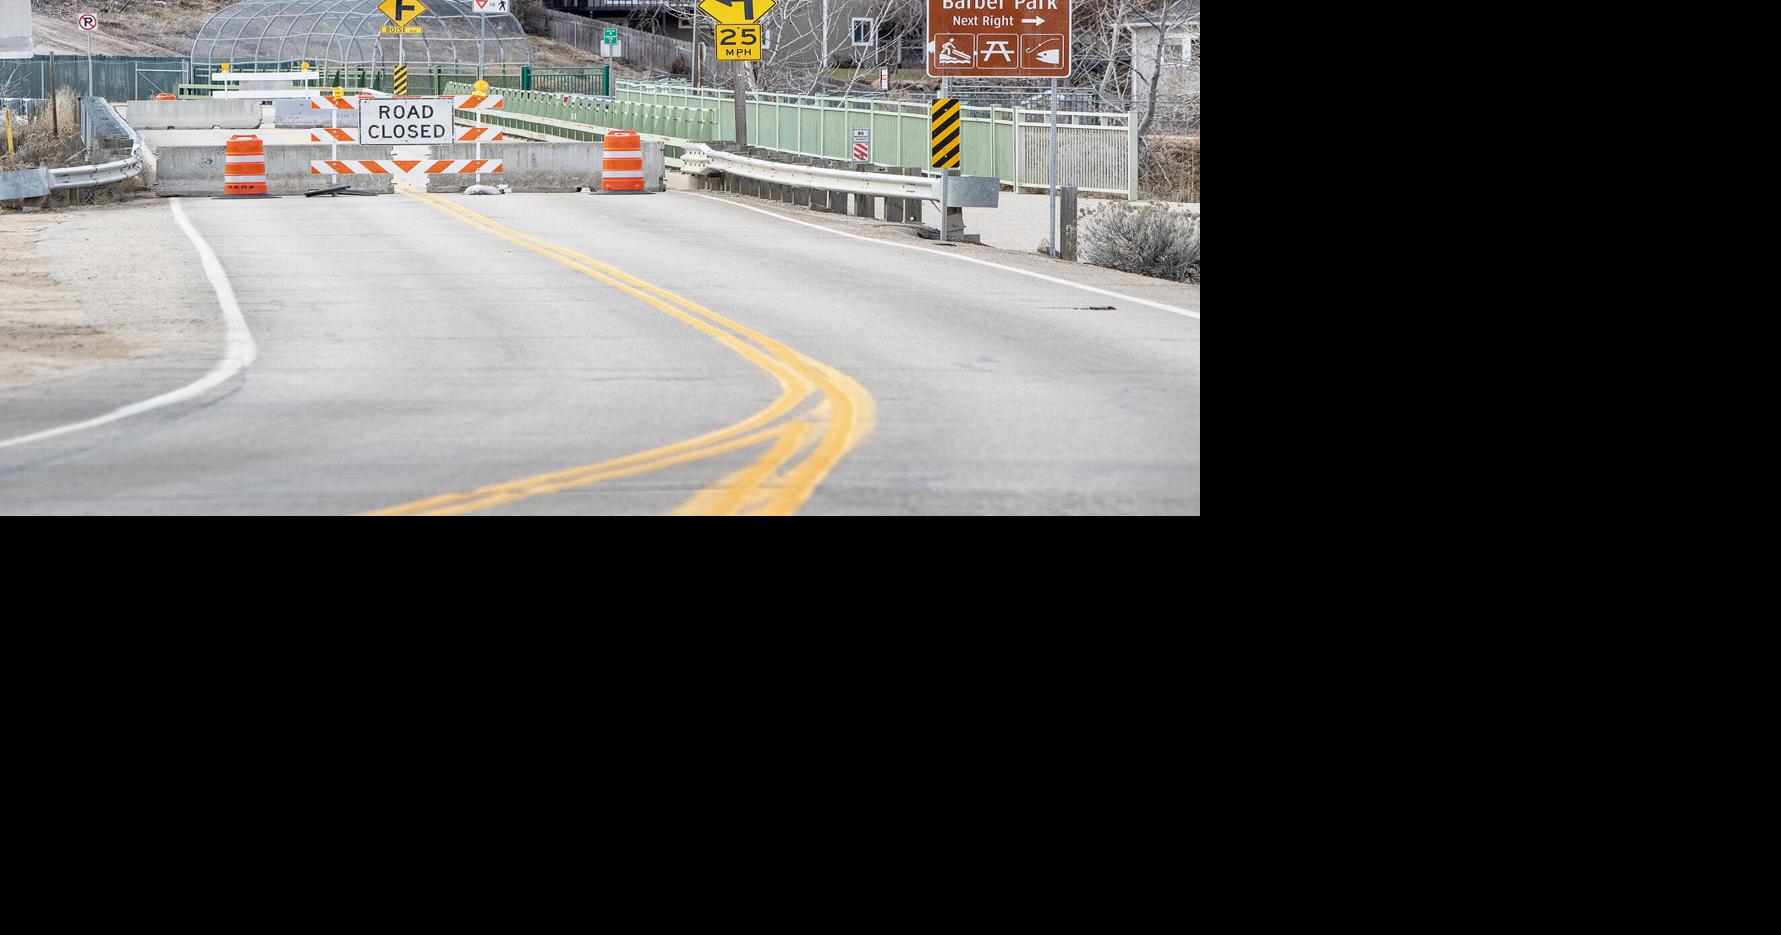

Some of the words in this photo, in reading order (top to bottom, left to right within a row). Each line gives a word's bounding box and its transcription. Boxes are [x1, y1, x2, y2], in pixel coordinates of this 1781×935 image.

[943, 0, 1004, 10] Barber
[1015, 0, 1058, 10] Park
[953, 15, 978, 26] Next
[982, 15, 1014, 28] Right
[720, 28, 757, 46] 25
[725, 48, 752, 56] MPH
[378, 104, 434, 119] ROAD
[368, 124, 446, 139] CLOSED
